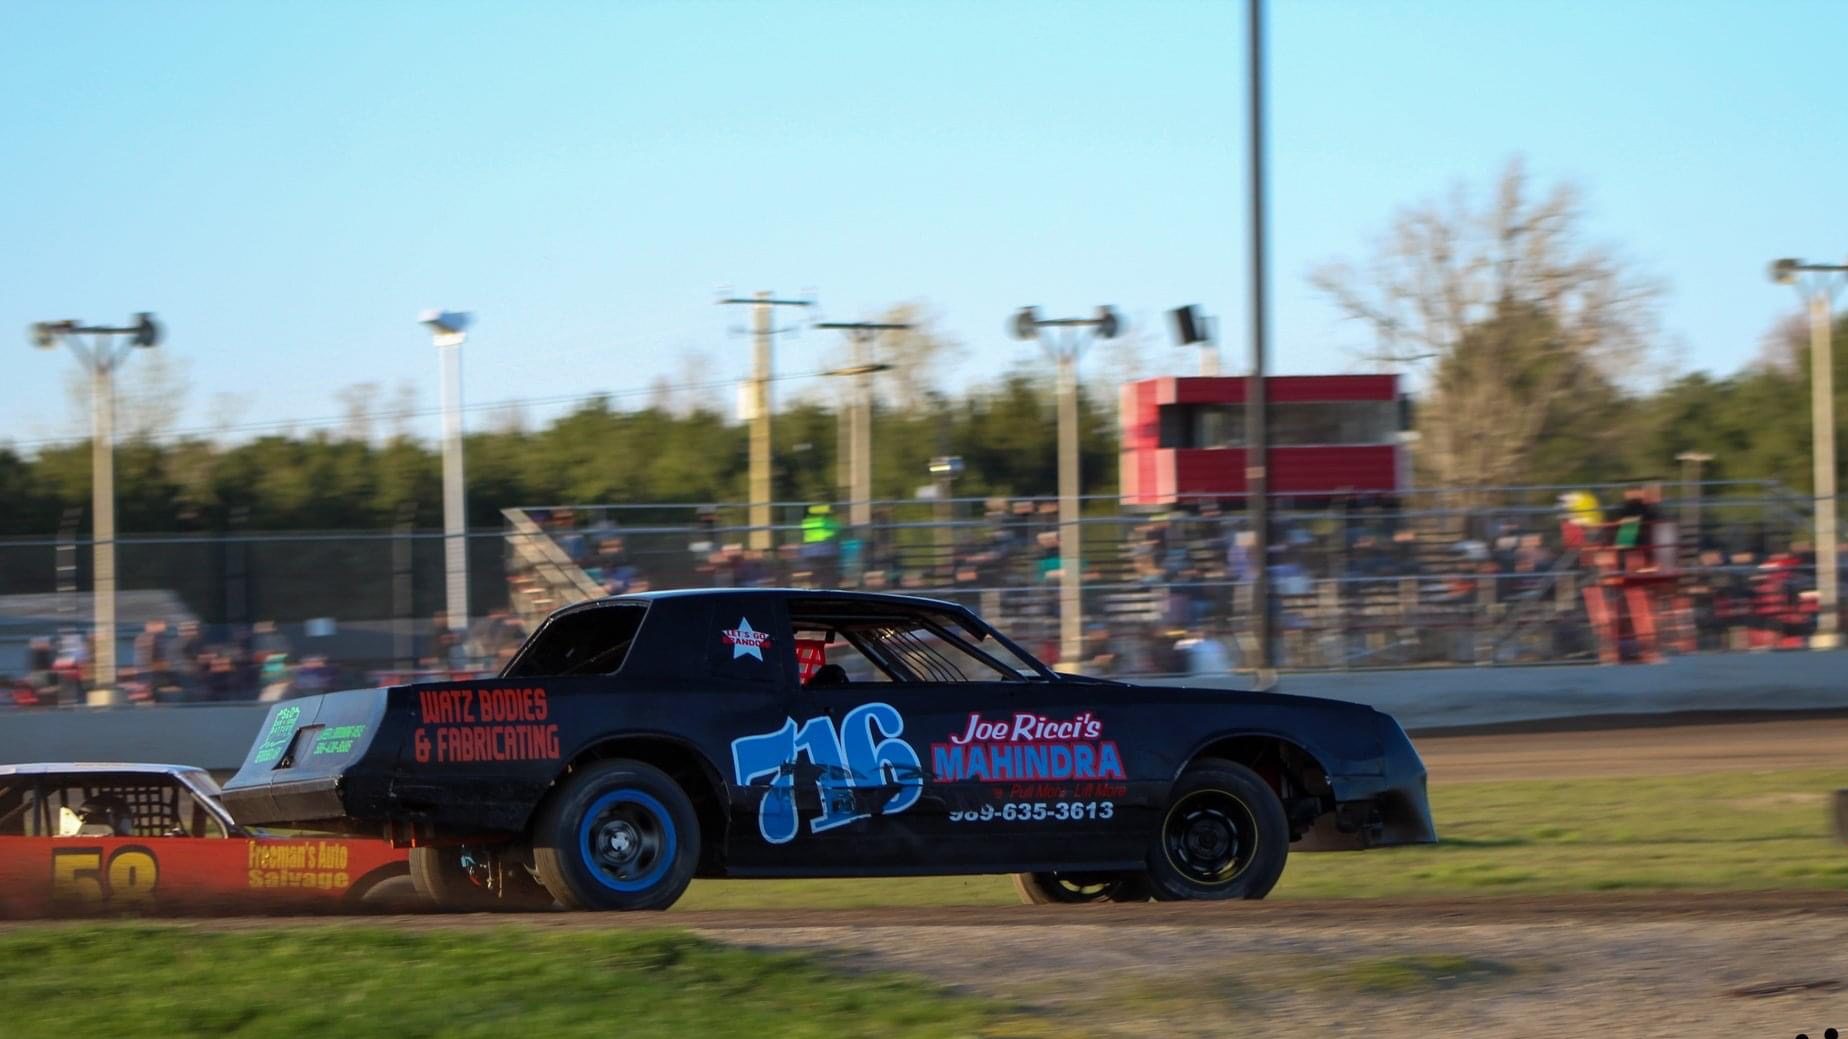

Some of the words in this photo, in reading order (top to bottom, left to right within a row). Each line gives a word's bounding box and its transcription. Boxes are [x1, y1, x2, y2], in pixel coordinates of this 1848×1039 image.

[753, 632, 766, 640] GO
[419, 690, 475, 725] WATZ
[481, 687, 548, 721] BODIES
[415, 732, 432, 762] &
[437, 724, 560, 763] FABRICATING
[952, 713, 1007, 745] Joe
[1010, 711, 1102, 742] Ricci's
[731, 701, 924, 845] 716
[932, 742, 1127, 783] MAHINDRA
[1010, 784, 1034, 798] Pull
[1074, 784, 1092, 798] Lift
[1095, 784, 1127, 798] More
[248, 840, 316, 869] Freeman's
[318, 841, 349, 869] Auto
[248, 869, 350, 890] Salvage
